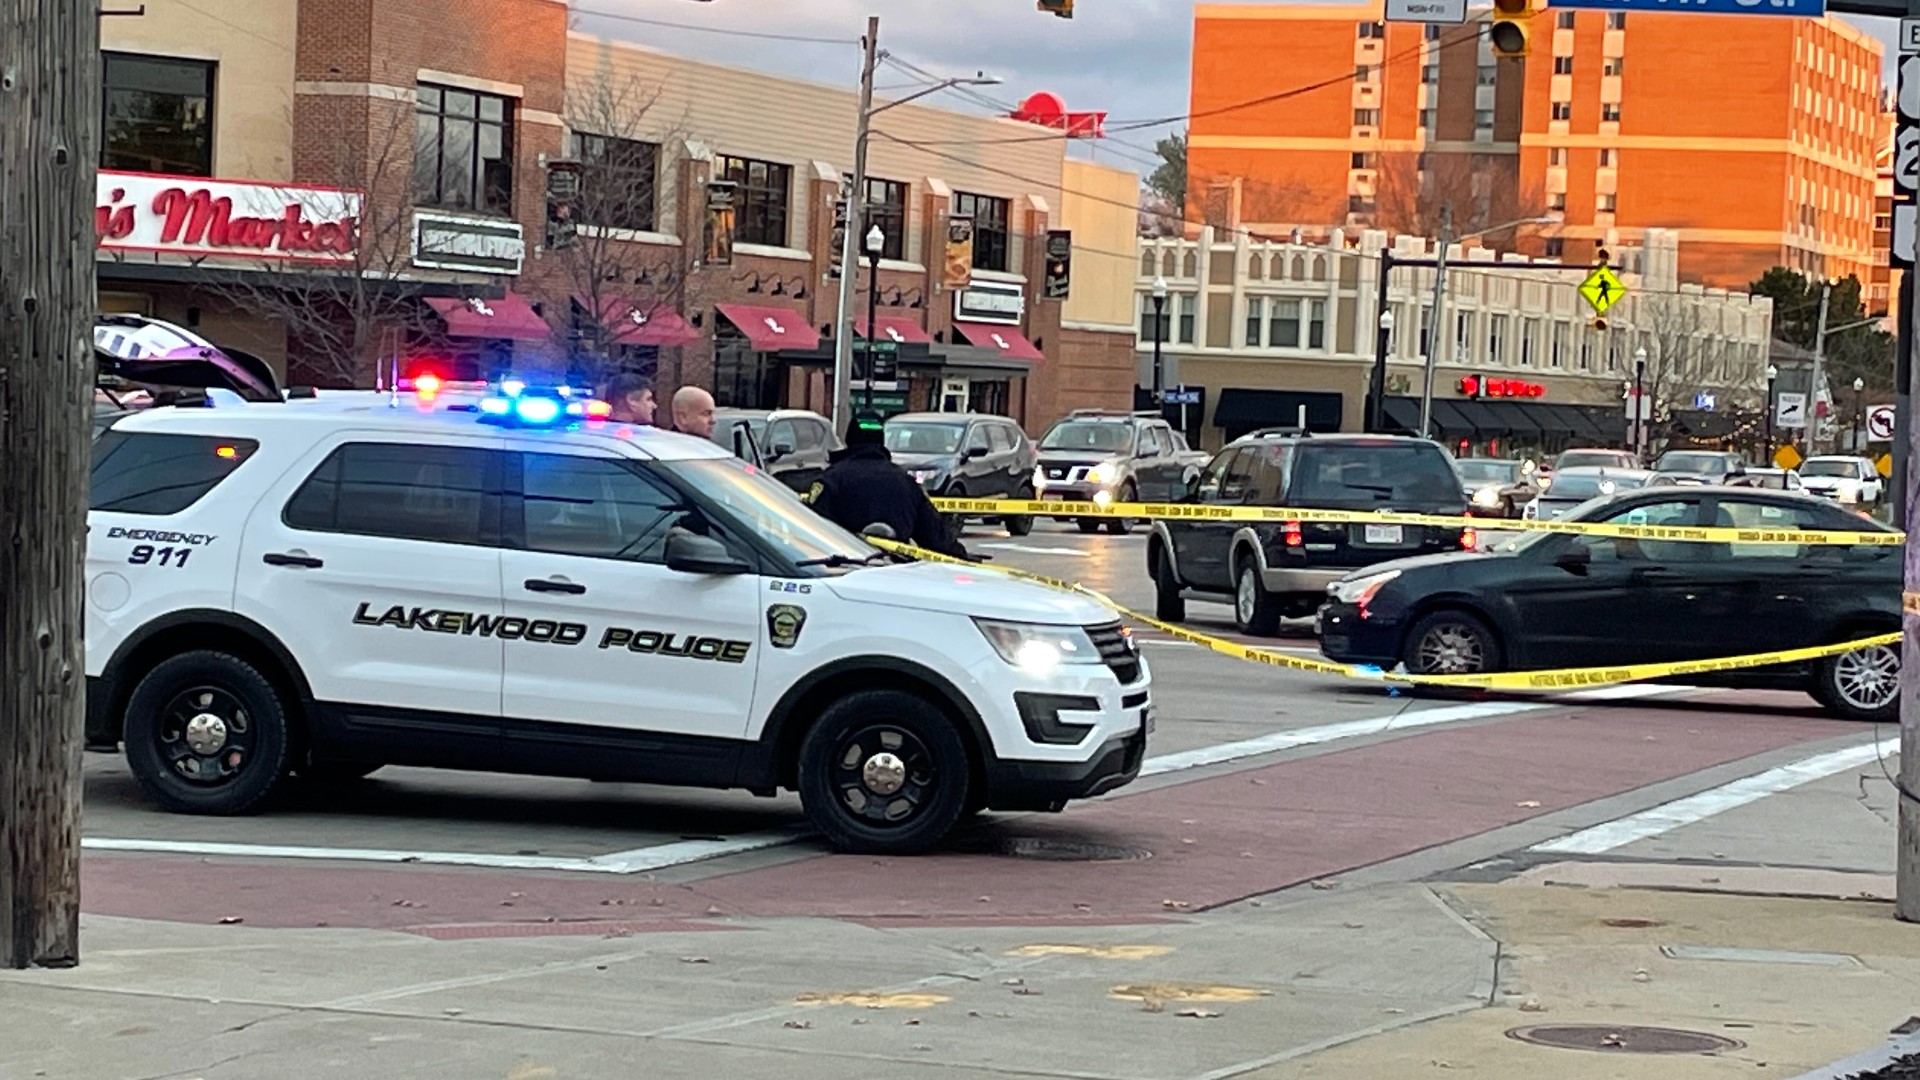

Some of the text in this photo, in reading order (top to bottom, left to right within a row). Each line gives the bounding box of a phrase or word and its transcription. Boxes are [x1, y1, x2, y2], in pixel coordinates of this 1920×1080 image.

[107, 526, 218, 546] EMERGENCY
[128, 544, 192, 568] 911
[352, 601, 753, 664] LAKEWOOD POLICE
